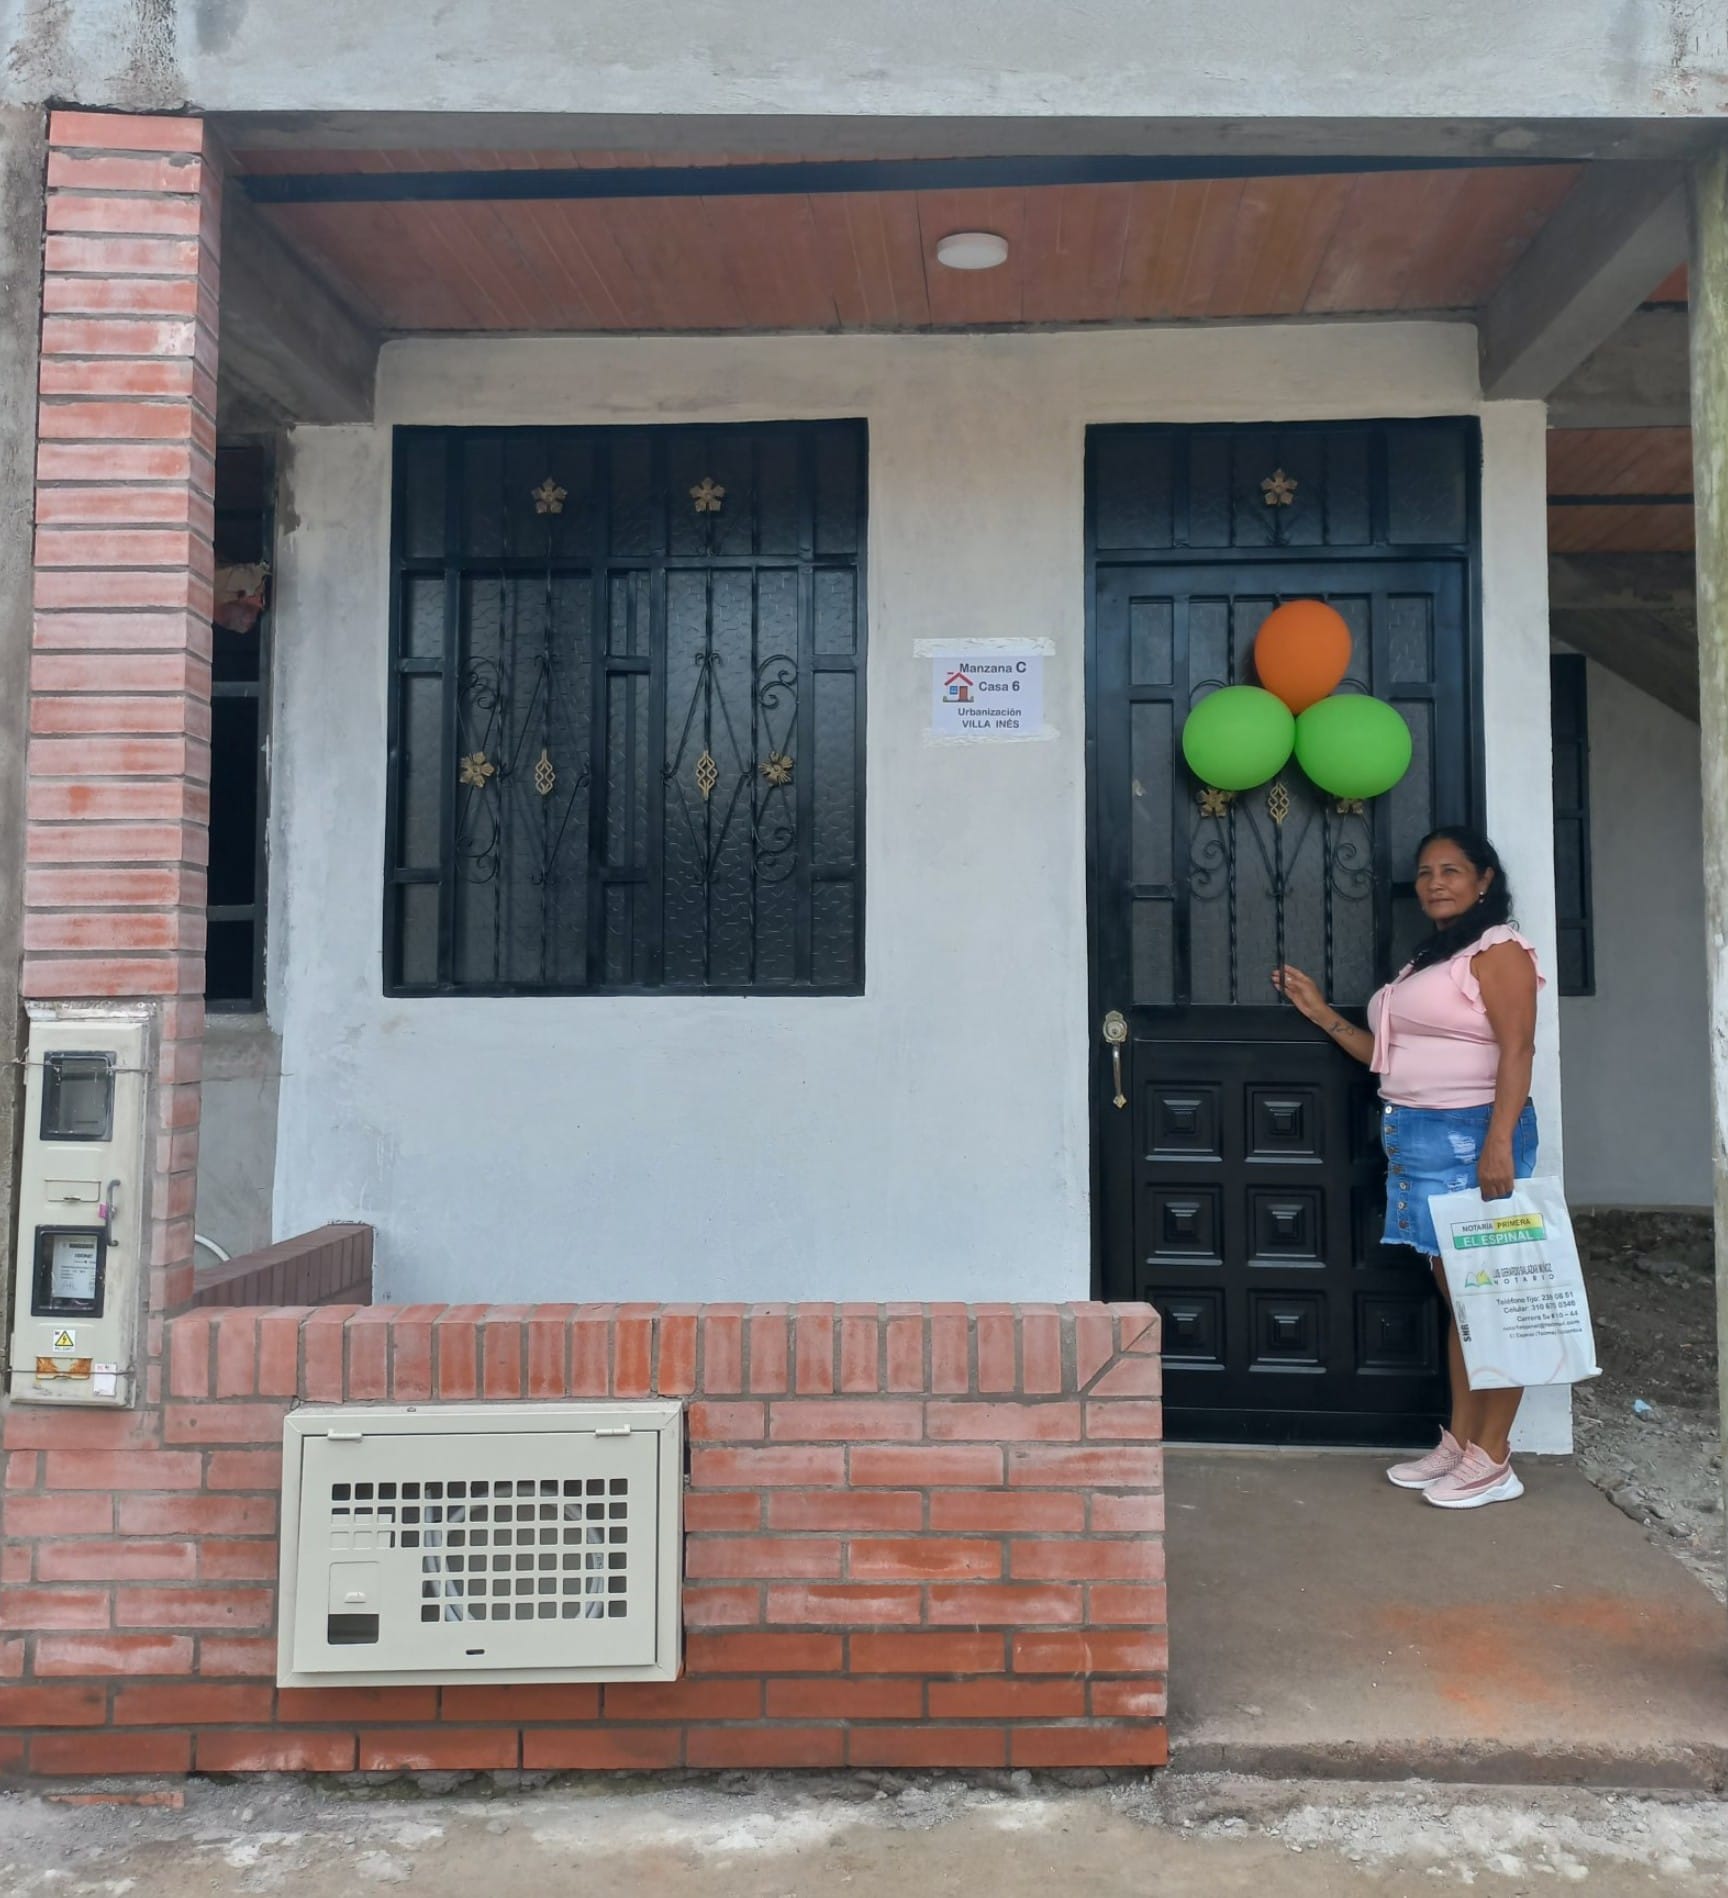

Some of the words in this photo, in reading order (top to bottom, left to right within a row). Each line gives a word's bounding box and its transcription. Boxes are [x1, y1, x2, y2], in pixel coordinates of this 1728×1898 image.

[960, 663, 1012, 673] Manzana
[1015, 661, 1027, 673] C
[979, 681, 1009, 692] Casa
[1012, 681, 1020, 691] 6
[958, 708, 1022, 716] Urbanización
[962, 720, 991, 728] VILLA
[996, 718, 1020, 728] INÉS
[1497, 1218, 1531, 1229] PRIMERA
[1463, 1237, 1479, 1247] EL
[1481, 1230, 1533, 1245] ESPINAL
[1494, 1274, 1554, 1285] NOTARIO
